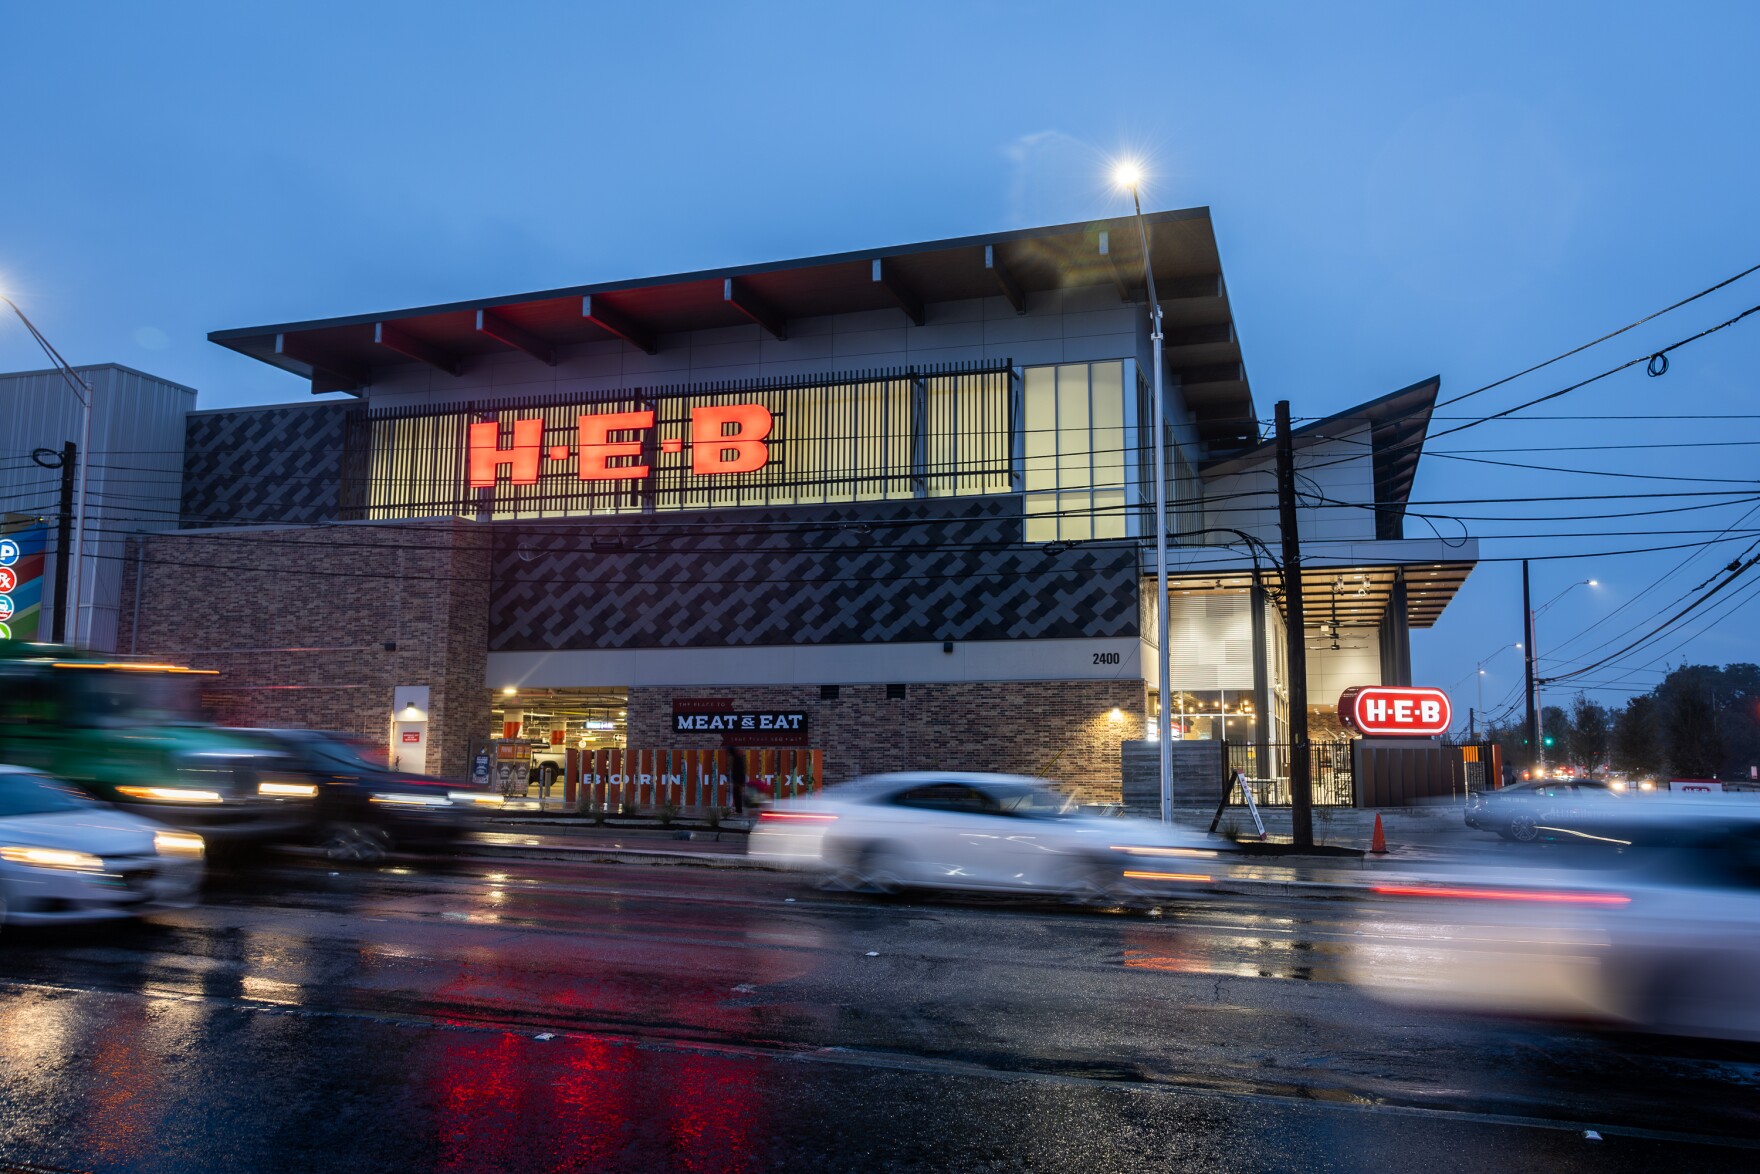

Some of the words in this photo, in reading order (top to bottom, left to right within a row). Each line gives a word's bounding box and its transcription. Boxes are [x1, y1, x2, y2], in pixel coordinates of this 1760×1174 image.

[1092, 652, 1120, 665] 2400
[677, 715, 738, 730] MEAT
[741, 715, 755, 729] &
[759, 714, 803, 729] EAT
